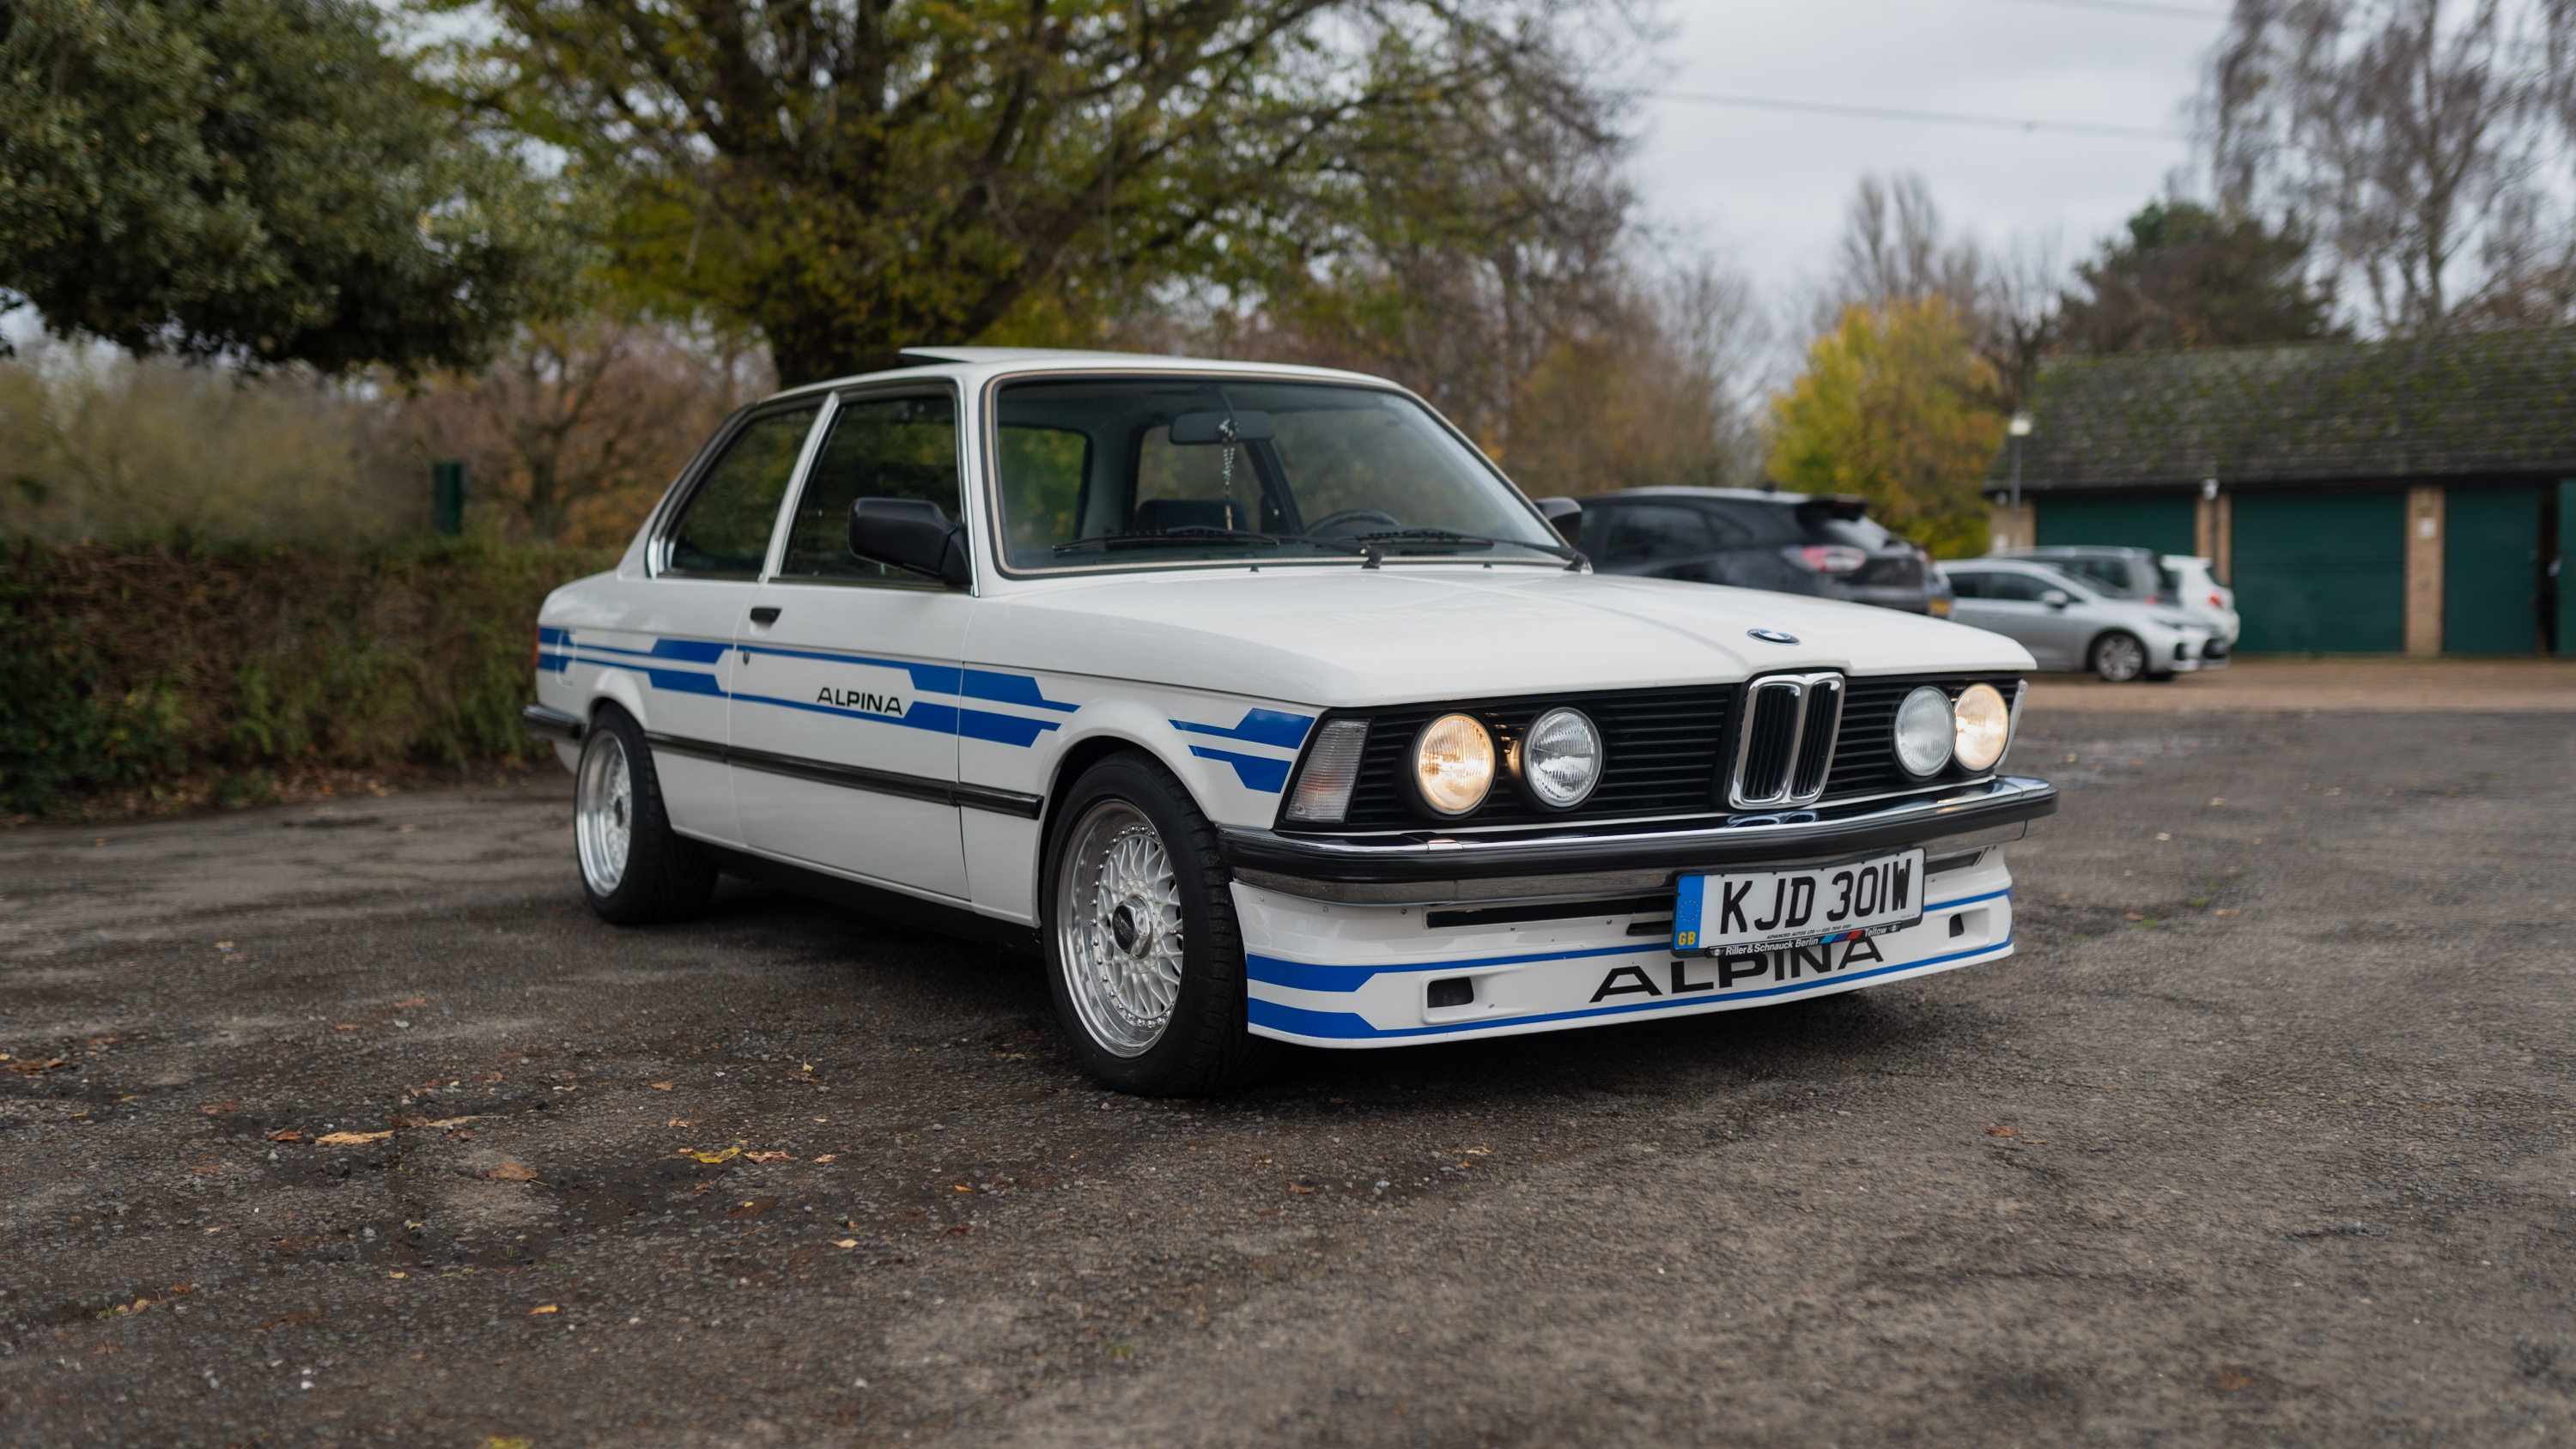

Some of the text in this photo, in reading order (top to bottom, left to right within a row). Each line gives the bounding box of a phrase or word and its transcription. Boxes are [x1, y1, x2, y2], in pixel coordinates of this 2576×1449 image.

[816, 686, 902, 716] ALPINA
[1719, 858, 1912, 935] KJD 301W
[1678, 931, 1697, 946] GB
[1795, 937, 1820, 948] Berlin
[1864, 926, 1887, 937] Teltow
[1589, 936, 1885, 1003] ALPINA
